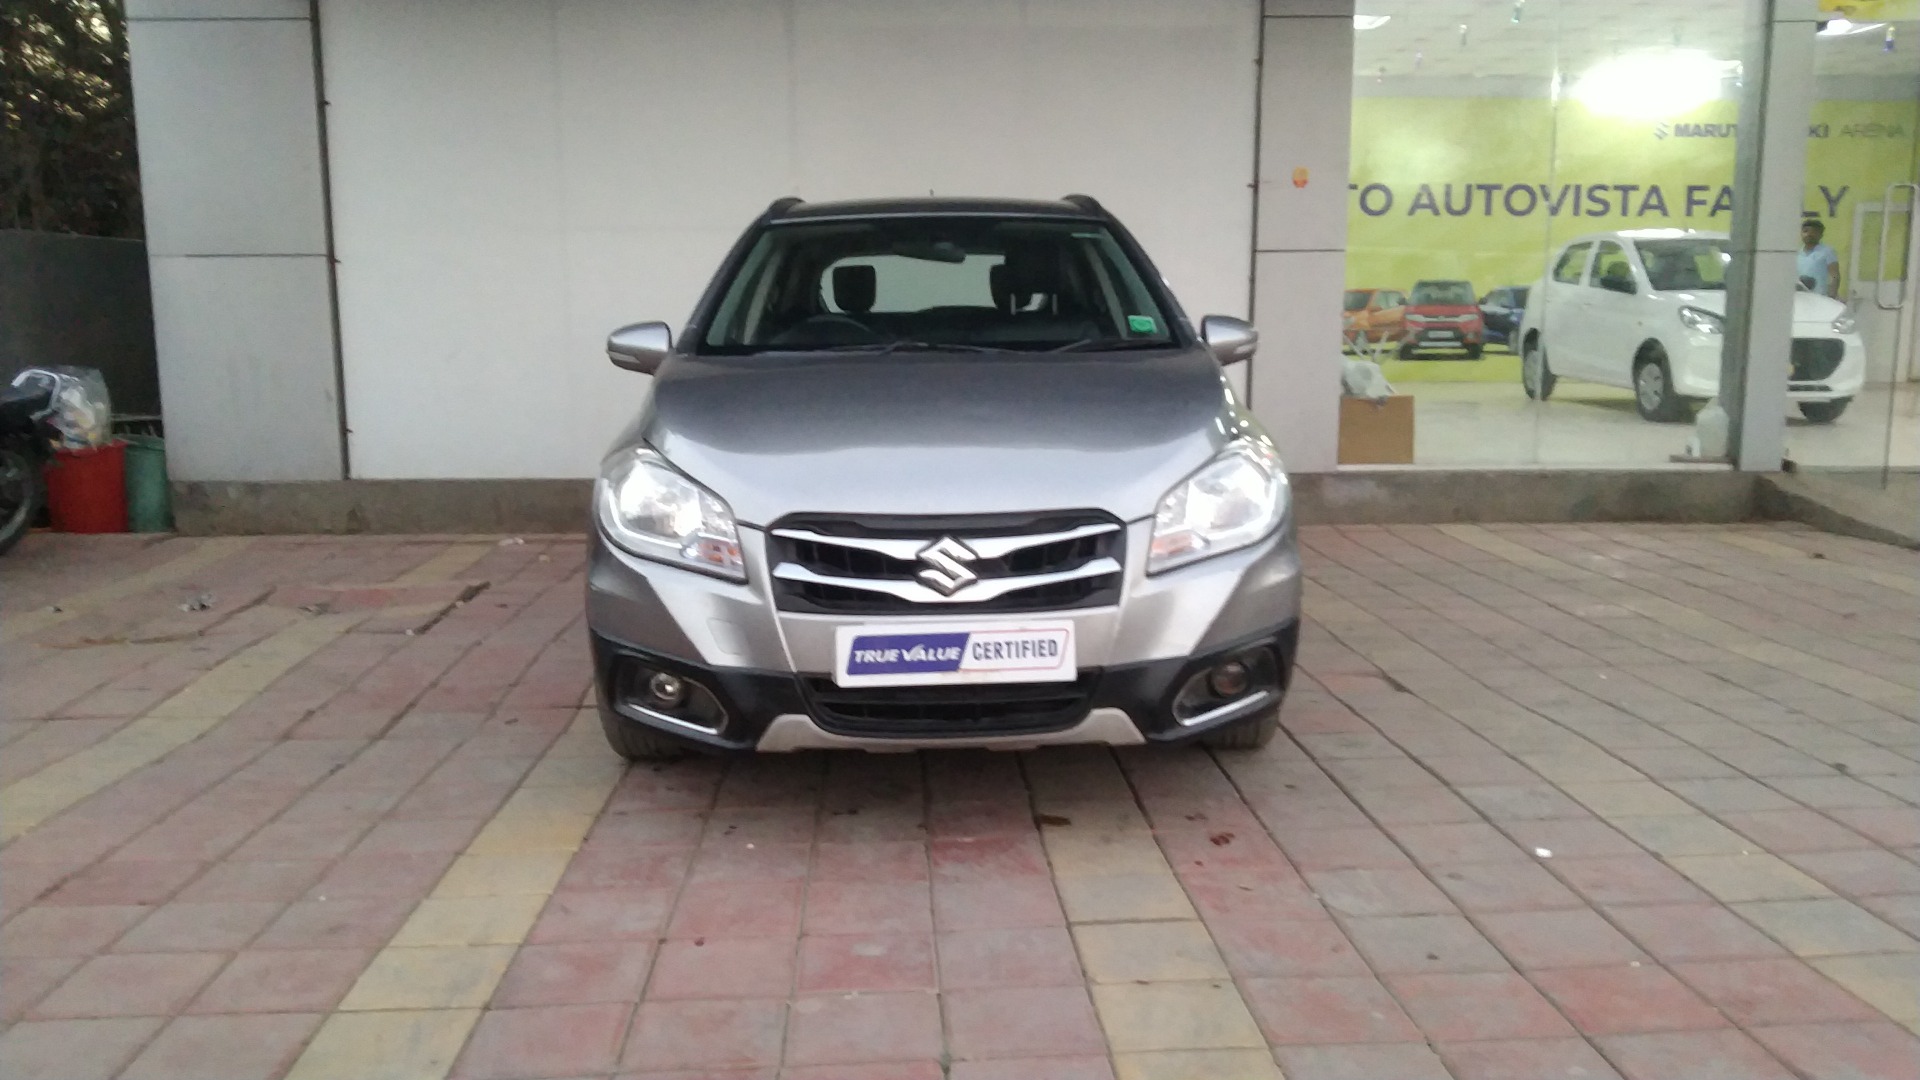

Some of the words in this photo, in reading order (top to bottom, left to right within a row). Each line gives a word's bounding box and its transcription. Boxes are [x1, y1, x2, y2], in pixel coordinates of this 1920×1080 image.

[1674, 123, 1738, 138] MARUT
[1407, 183, 1670, 217] AUTOVISTA
[853, 648, 900, 664] TRUE
[901, 643, 962, 662] VALUE
[972, 638, 1059, 661] CERTIFIED
